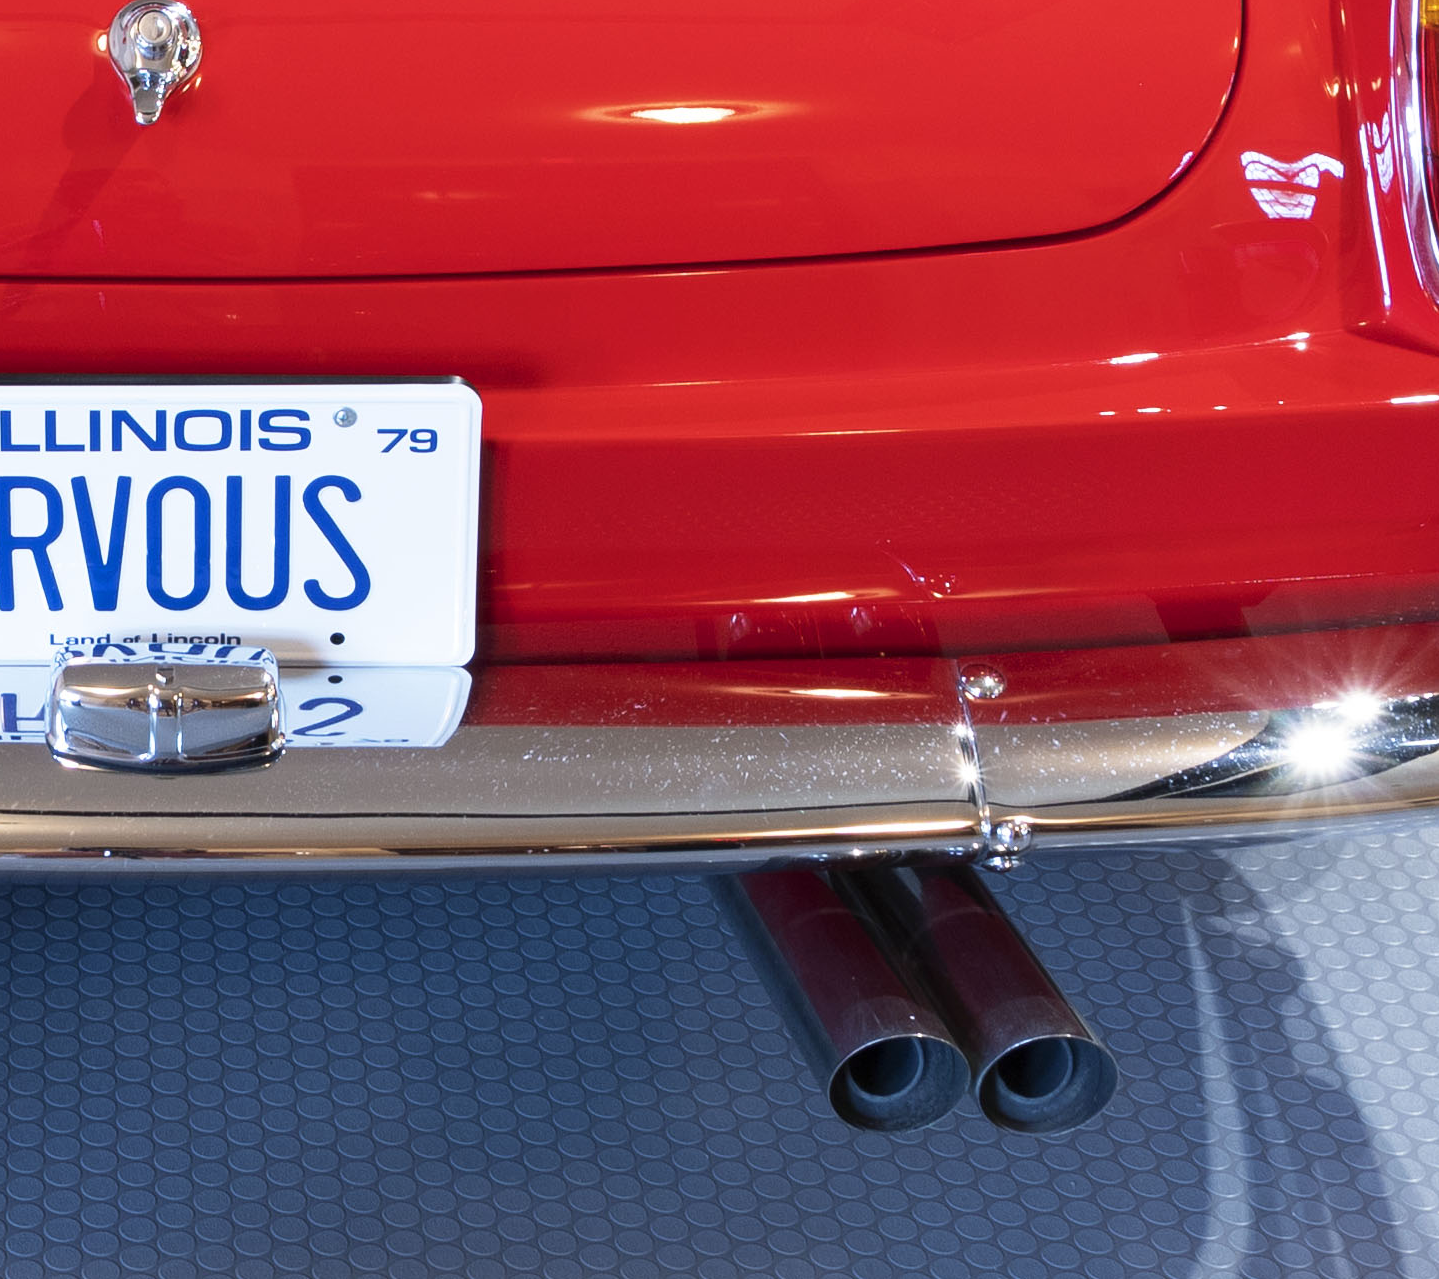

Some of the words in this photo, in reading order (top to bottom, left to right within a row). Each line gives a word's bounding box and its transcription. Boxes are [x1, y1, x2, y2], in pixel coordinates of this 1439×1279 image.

[377, 428, 438, 453] 79
[49, 633, 111, 645] Land
[123, 634, 142, 645] of
[152, 632, 242, 645] Lincoln
